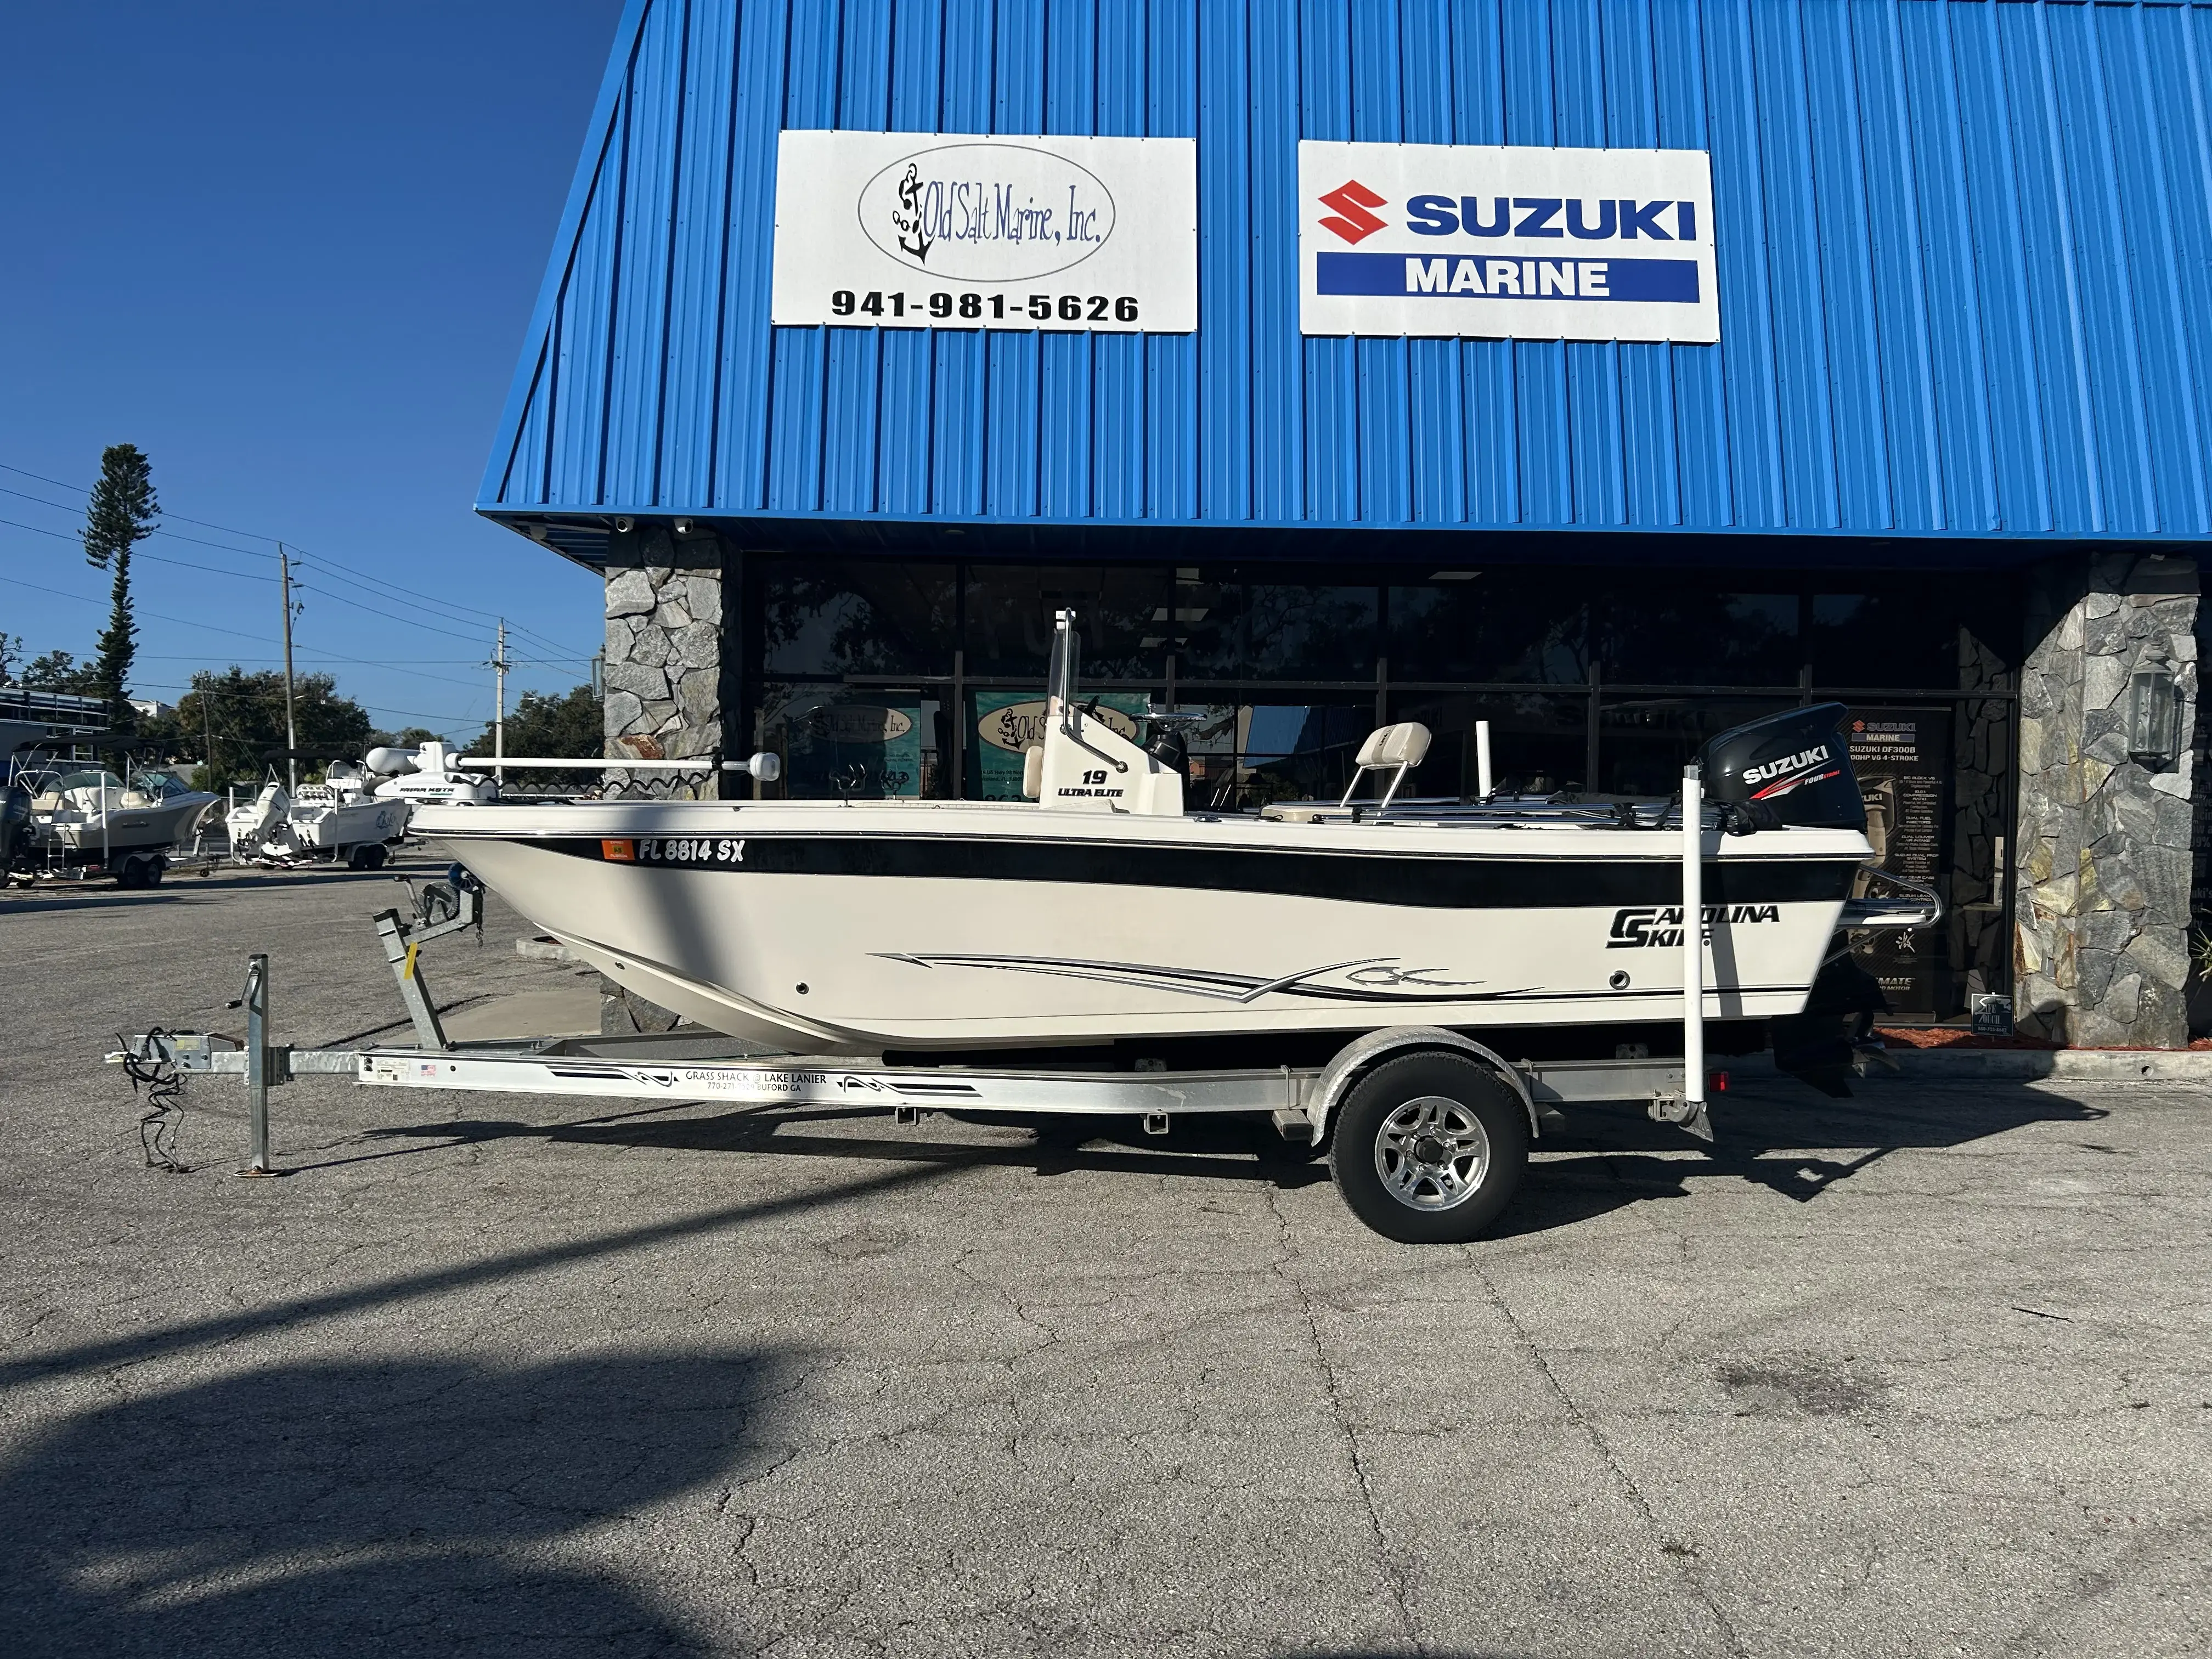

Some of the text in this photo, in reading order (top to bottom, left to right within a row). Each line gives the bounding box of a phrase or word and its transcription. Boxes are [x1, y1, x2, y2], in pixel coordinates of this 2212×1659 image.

[923, 181, 1101, 246] Old Salt Marine, Inc.
[1406, 194, 1696, 241] SUZUKI
[1405, 258, 1610, 297] MARINE
[831, 290, 1139, 322] 941-981-5626
[1018, 716, 1036, 740] Old
[1867, 722, 1917, 731] SUZUKI
[1742, 745, 1829, 785] SUZUKI
[1083, 770, 1108, 785] 19
[1058, 788, 1124, 797] ULTRA ELITE
[1862, 793, 1882, 802] UKI
[639, 839, 746, 862] FL 8814 SX
[1610, 905, 1780, 938] CAOLINA
[1605, 918, 1715, 949] SKIF
[1876, 977, 1912, 986] MATE
[686, 1071, 827, 1084] GRASS SHACK @ LAKE LANIER
[757, 1084, 788, 1092] BUFORD
